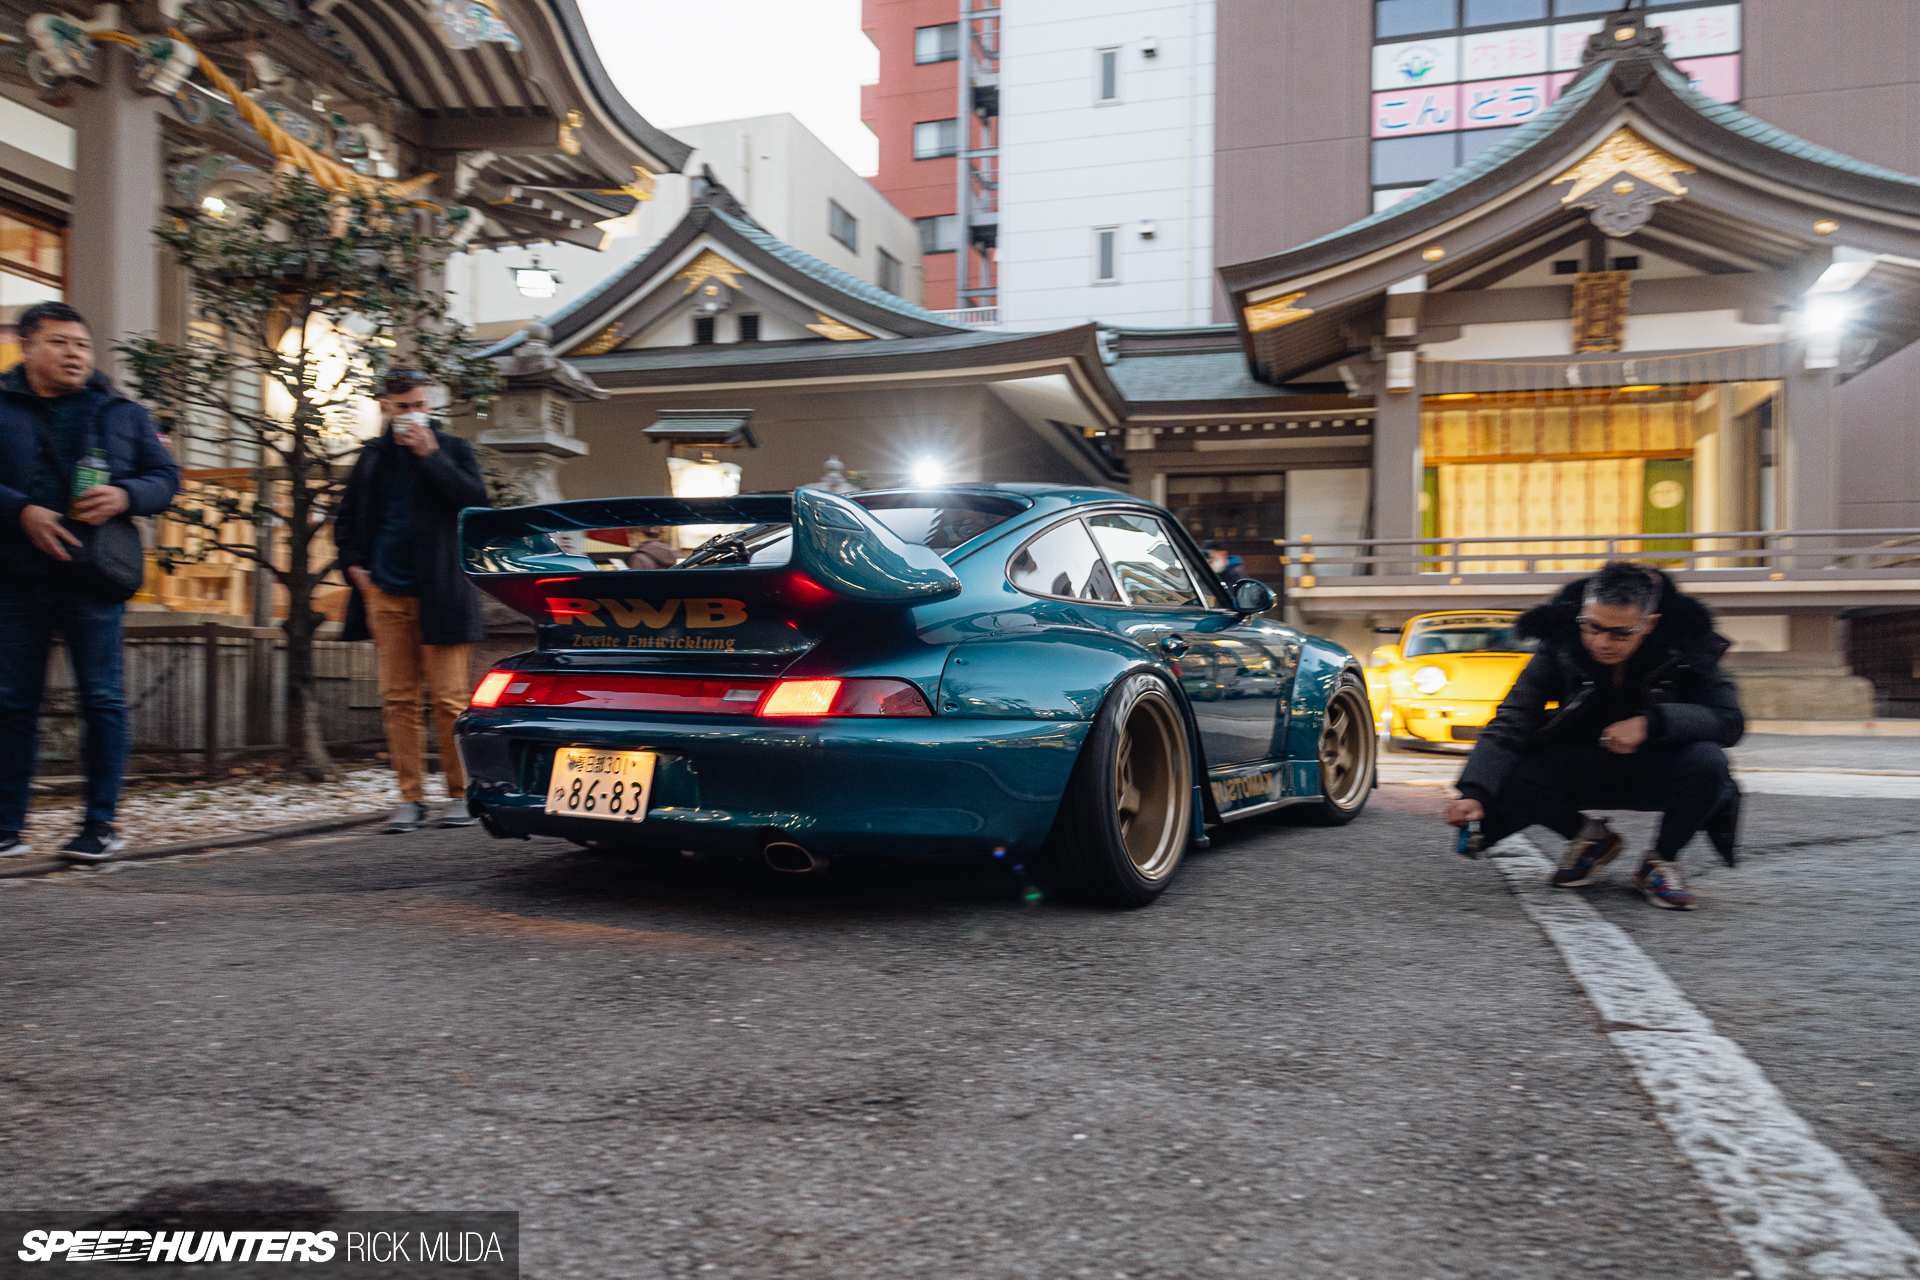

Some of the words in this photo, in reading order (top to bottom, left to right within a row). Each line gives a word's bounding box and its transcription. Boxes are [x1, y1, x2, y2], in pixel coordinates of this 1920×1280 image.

[1378, 86, 1542, 129] こんどう
[545, 597, 748, 629] RWB
[572, 634, 621, 648] Zweite
[627, 635, 736, 653] Entwicklung
[568, 777, 642, 815] 86-83
